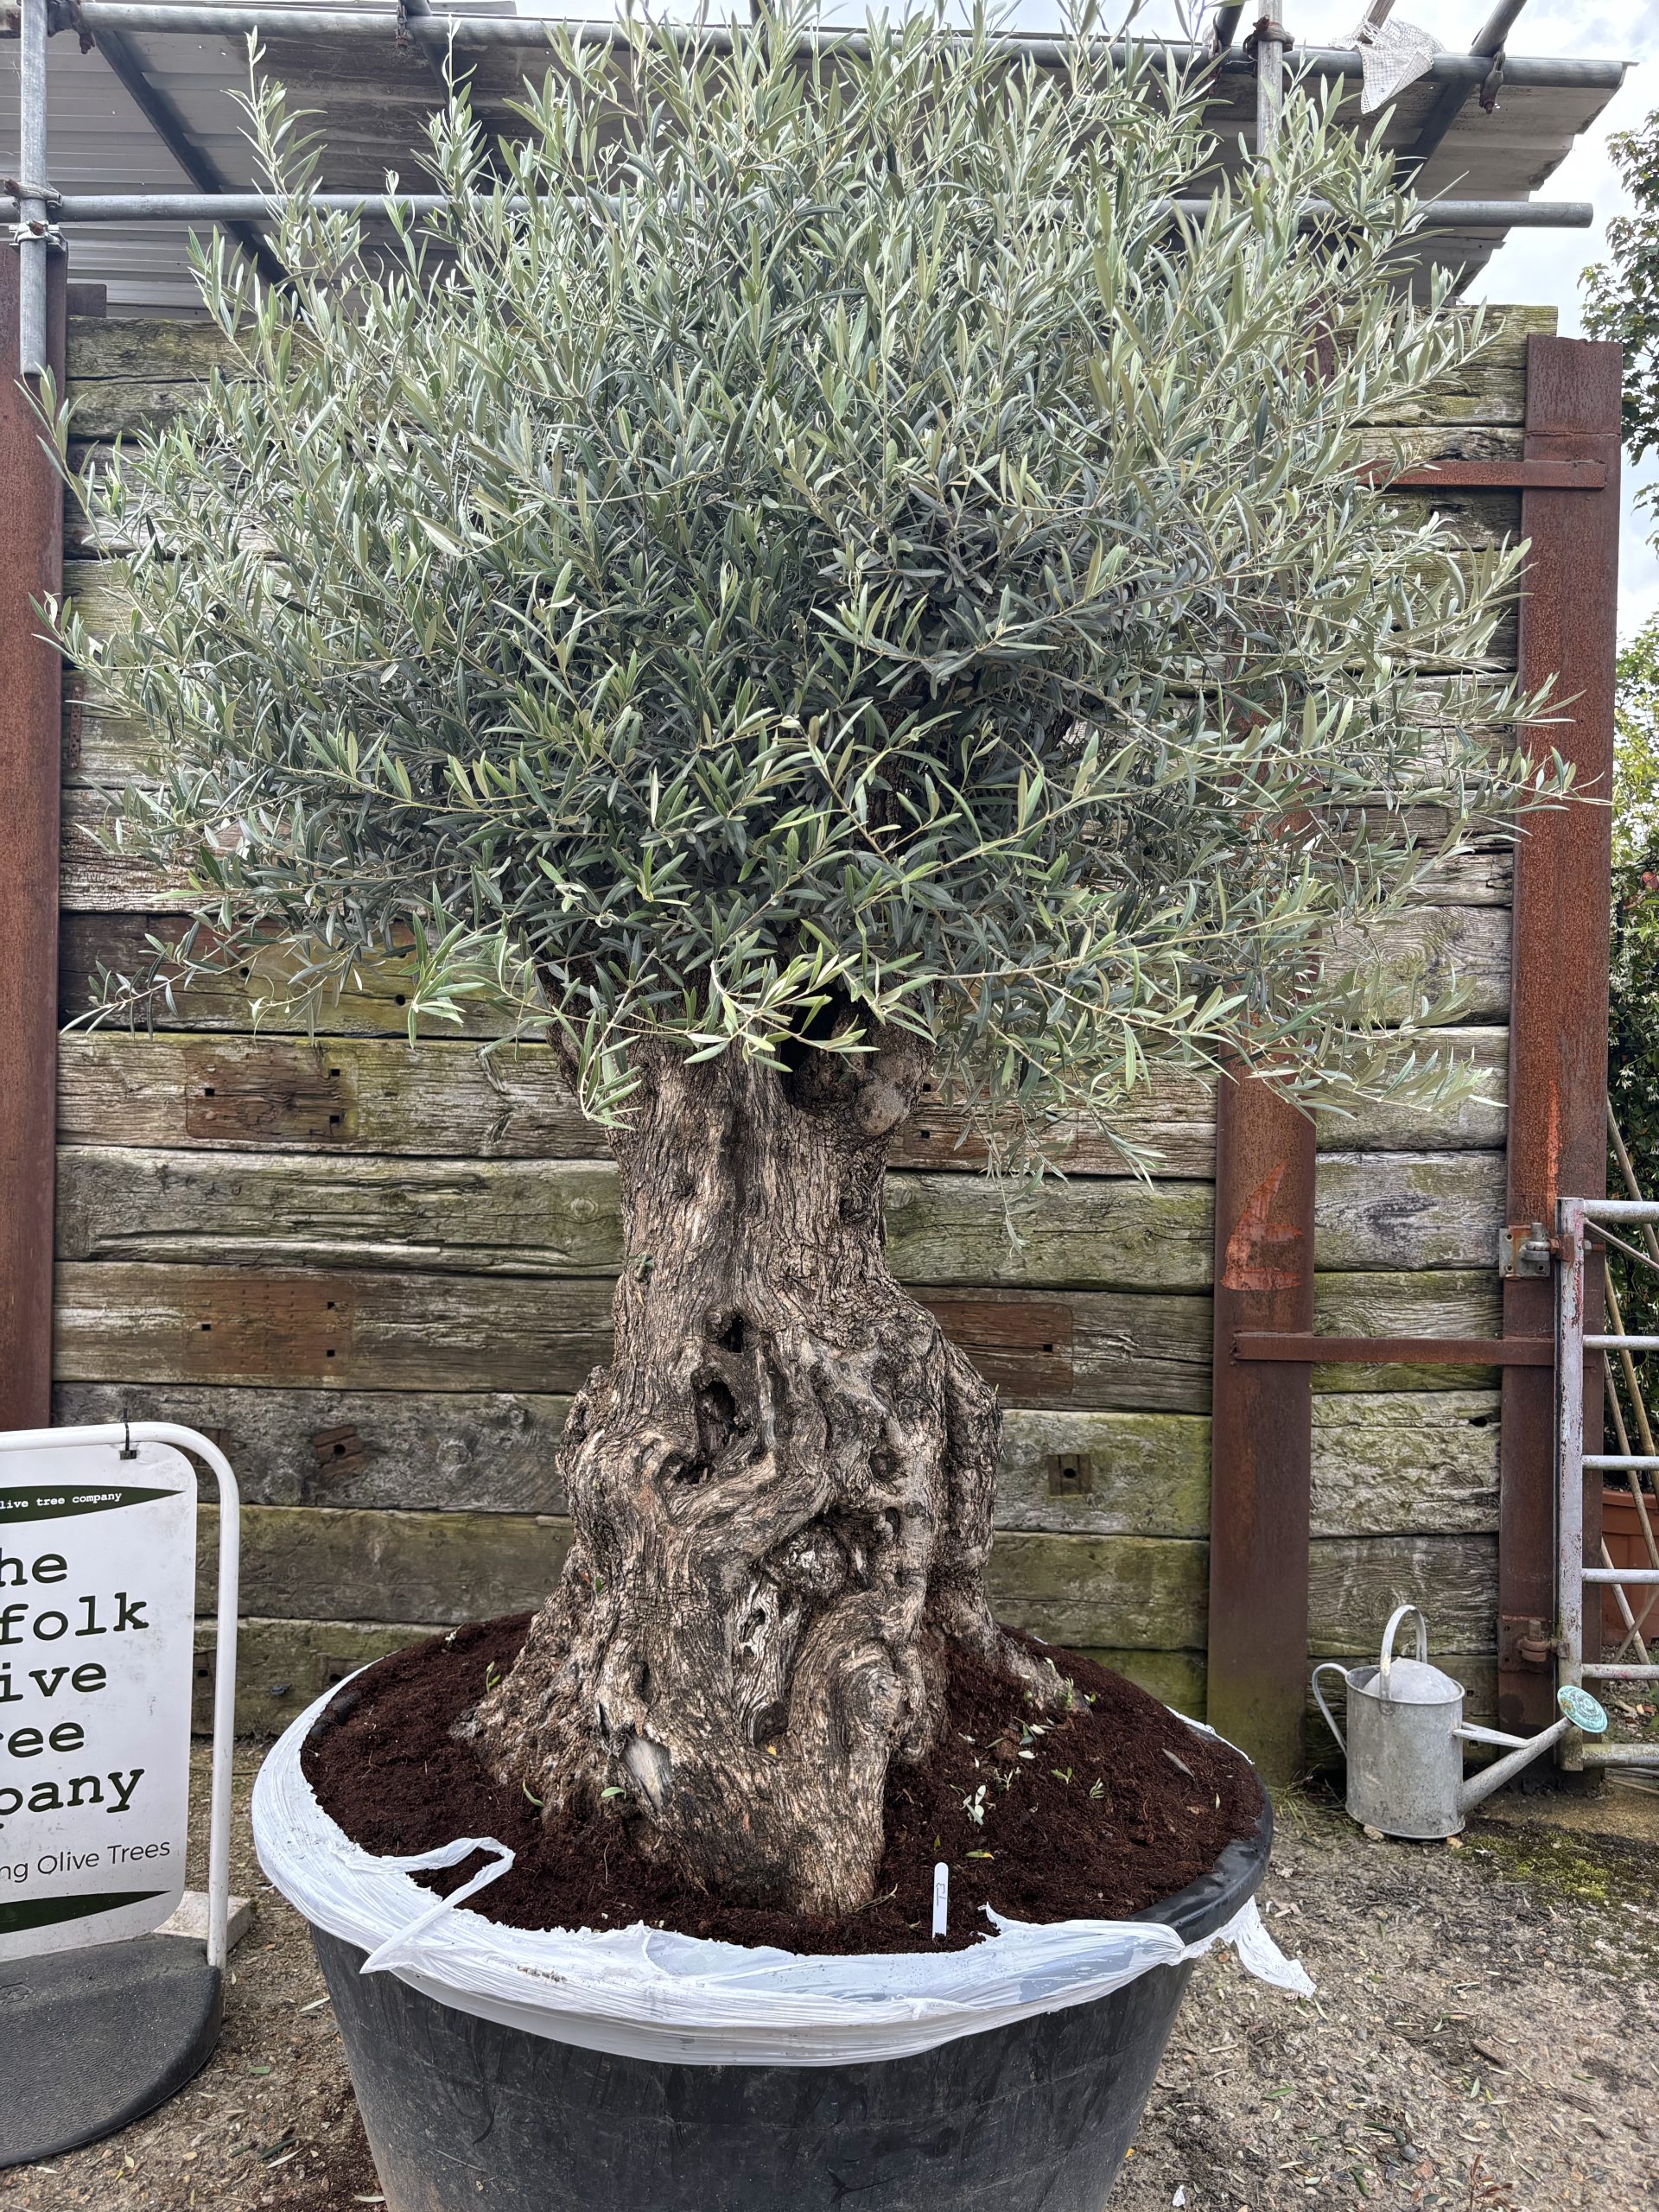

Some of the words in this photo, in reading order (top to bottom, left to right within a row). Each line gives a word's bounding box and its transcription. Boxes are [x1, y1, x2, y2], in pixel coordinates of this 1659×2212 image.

[0, 1500, 29, 1510] live
[35, 1497, 66, 1507] tree
[72, 1492, 123, 1504] company
[0, 1592, 149, 1646] folk
[0, 1662, 107, 1703] ive
[0, 1722, 85, 1758] ee
[37, 1851, 100, 1875] Olive
[106, 1841, 170, 1865] Trees
